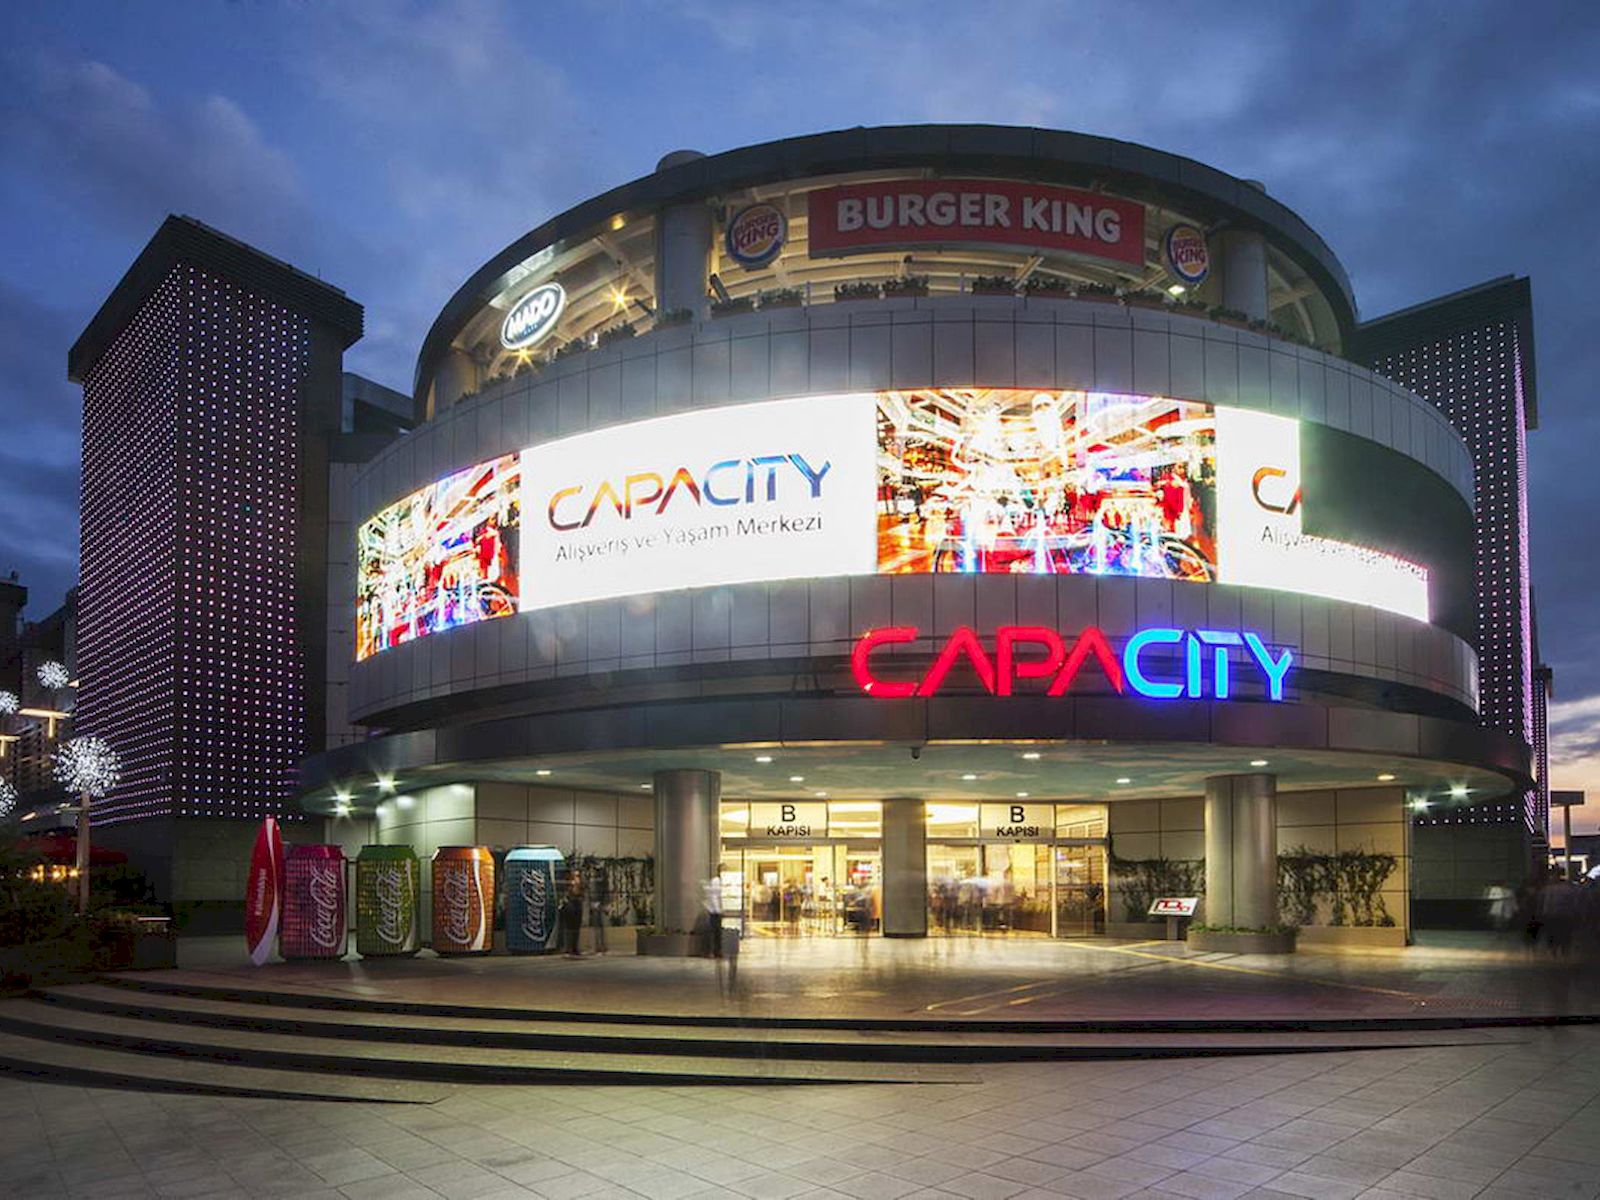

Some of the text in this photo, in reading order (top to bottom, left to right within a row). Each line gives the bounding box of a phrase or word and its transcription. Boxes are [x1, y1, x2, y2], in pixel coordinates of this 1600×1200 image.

[735, 222, 779, 250] KING
[837, 193, 1121, 243] BURGER KING
[1174, 247, 1207, 264] KING
[506, 290, 556, 339] MADO
[548, 452, 831, 532] CAPACITY
[634, 535, 657, 549] ve
[663, 523, 729, 545] Yaşam
[737, 512, 822, 538] Merkezi
[850, 626, 1294, 701] CAPACITY
[781, 804, 796, 822] B
[1010, 805, 1025, 823] B
